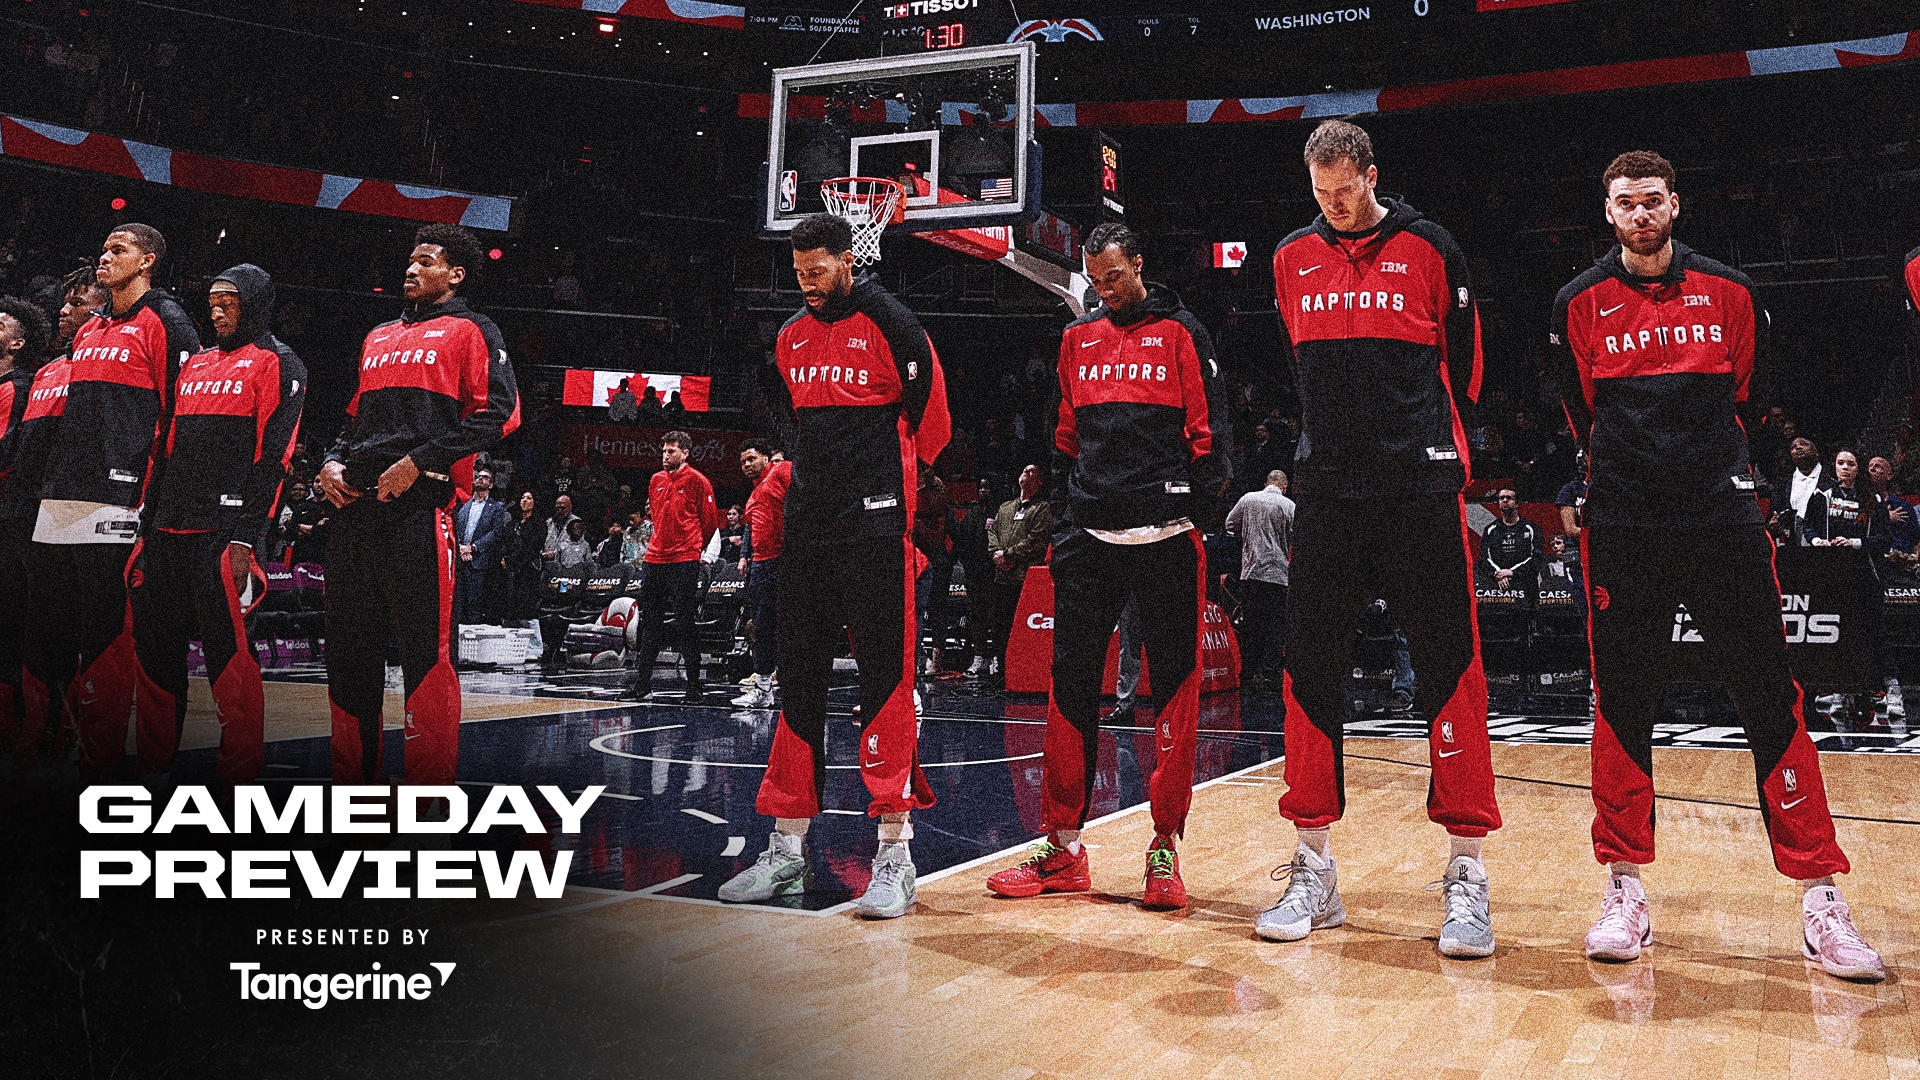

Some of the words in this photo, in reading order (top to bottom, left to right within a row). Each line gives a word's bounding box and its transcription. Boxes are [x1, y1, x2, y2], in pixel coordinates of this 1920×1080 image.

[810, 17, 860, 25] FOUNDATION
[1254, 7, 1370, 30] WASHINGTON
[925, 23, 963, 49] 1:30
[1144, 27, 1151, 37] 0
[1190, 25, 1197, 35] 7
[1380, 262, 1408, 274] IBM
[1301, 291, 1405, 312] RAPTORS
[1682, 295, 1711, 306] IBM
[847, 338, 867, 350] IBM
[1141, 337, 1163, 347] IBM
[1605, 324, 1722, 354] RAPTORS
[363, 349, 437, 371] RAPTORS
[790, 366, 868, 385] RAPTORS
[1079, 364, 1167, 381] RAPTORS
[32, 384, 69, 401] RAPTOR
[180, 380, 243, 395] RAPTORS
[1475, 590, 1525, 598] CAESARS
